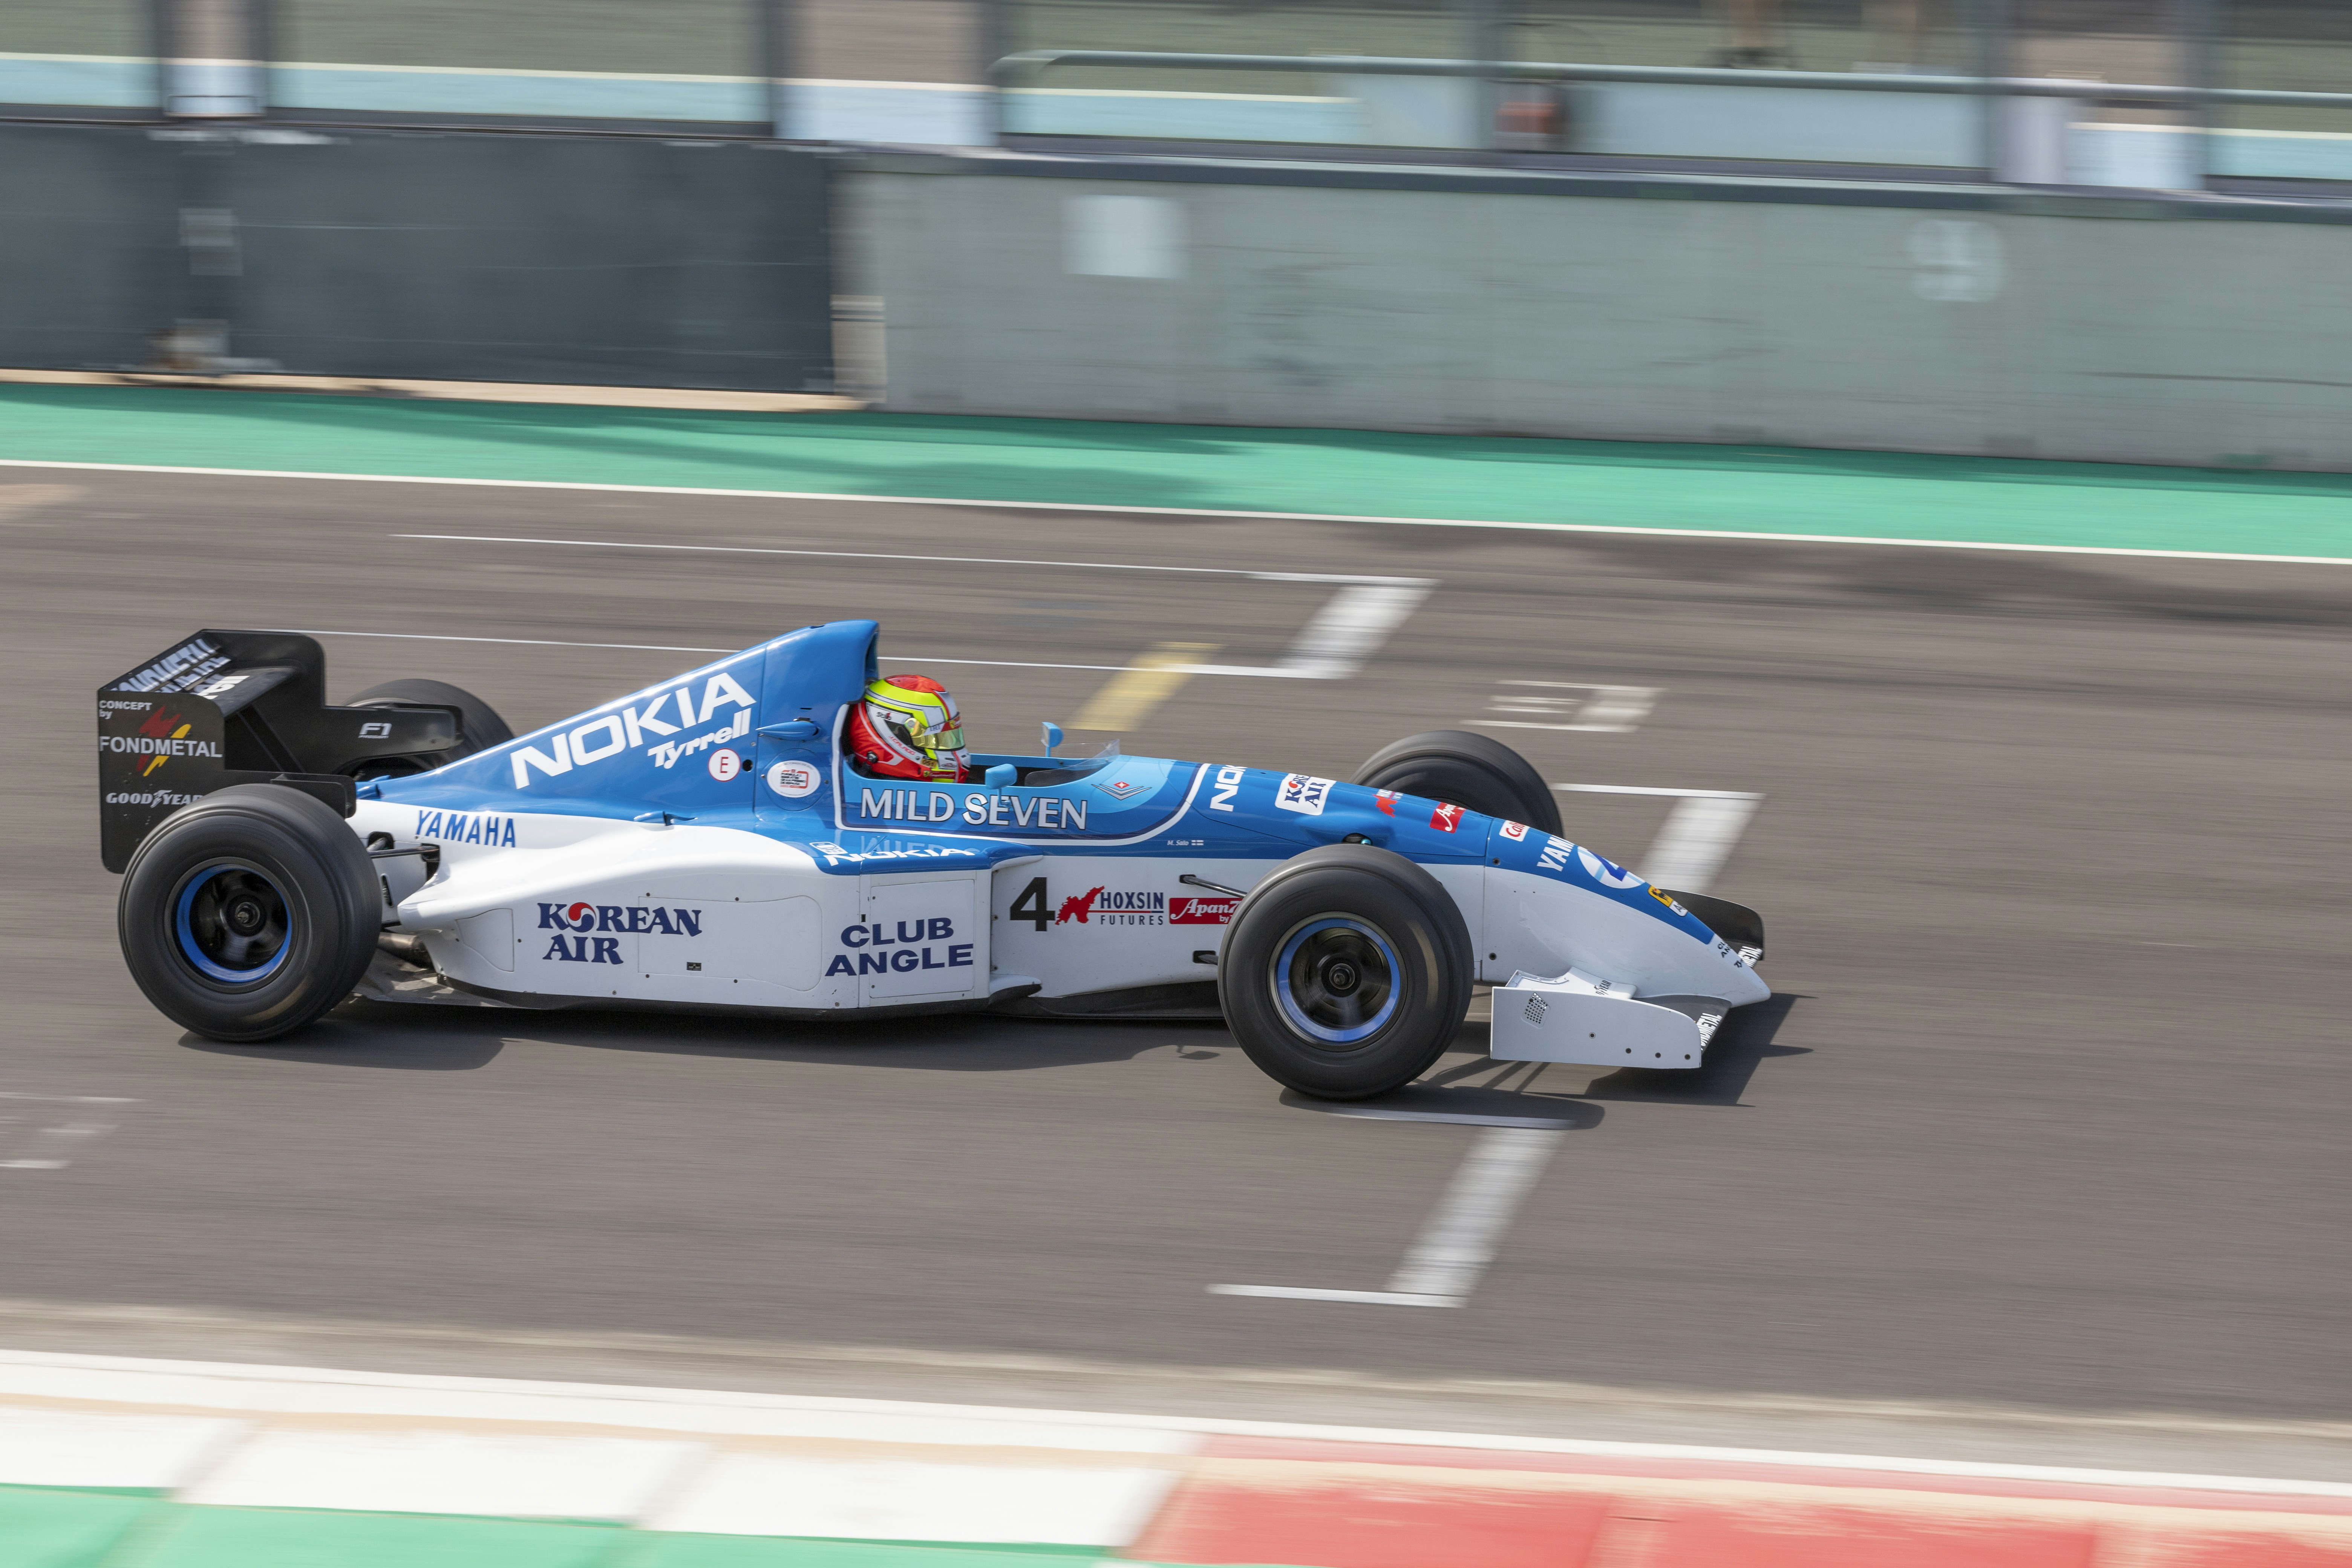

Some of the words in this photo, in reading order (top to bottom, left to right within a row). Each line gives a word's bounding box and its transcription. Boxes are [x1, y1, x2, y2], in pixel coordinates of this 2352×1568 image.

[99, 700, 152, 710] CONCEPT
[99, 709, 113, 719] by
[359, 723, 392, 735] F1
[510, 672, 756, 789] NOKIA
[647, 708, 752, 769] Tyrrell
[99, 736, 223, 758] FONDMETAL
[720, 756, 729, 773] E
[860, 788, 955, 823] MILD
[962, 793, 1087, 830] SEVEN
[1305, 782, 1326, 808] AIR
[416, 810, 516, 848] YAMAHA
[823, 848, 975, 866] NOKIA
[537, 902, 702, 937] KOREAN
[1009, 877, 1056, 932] 4
[1100, 892, 1164, 909] HOXSIN
[841, 917, 954, 948] CLUB
[1100, 915, 1164, 926] FUTURES
[542, 934, 624, 965] AIR
[825, 943, 974, 976] ANGLE
